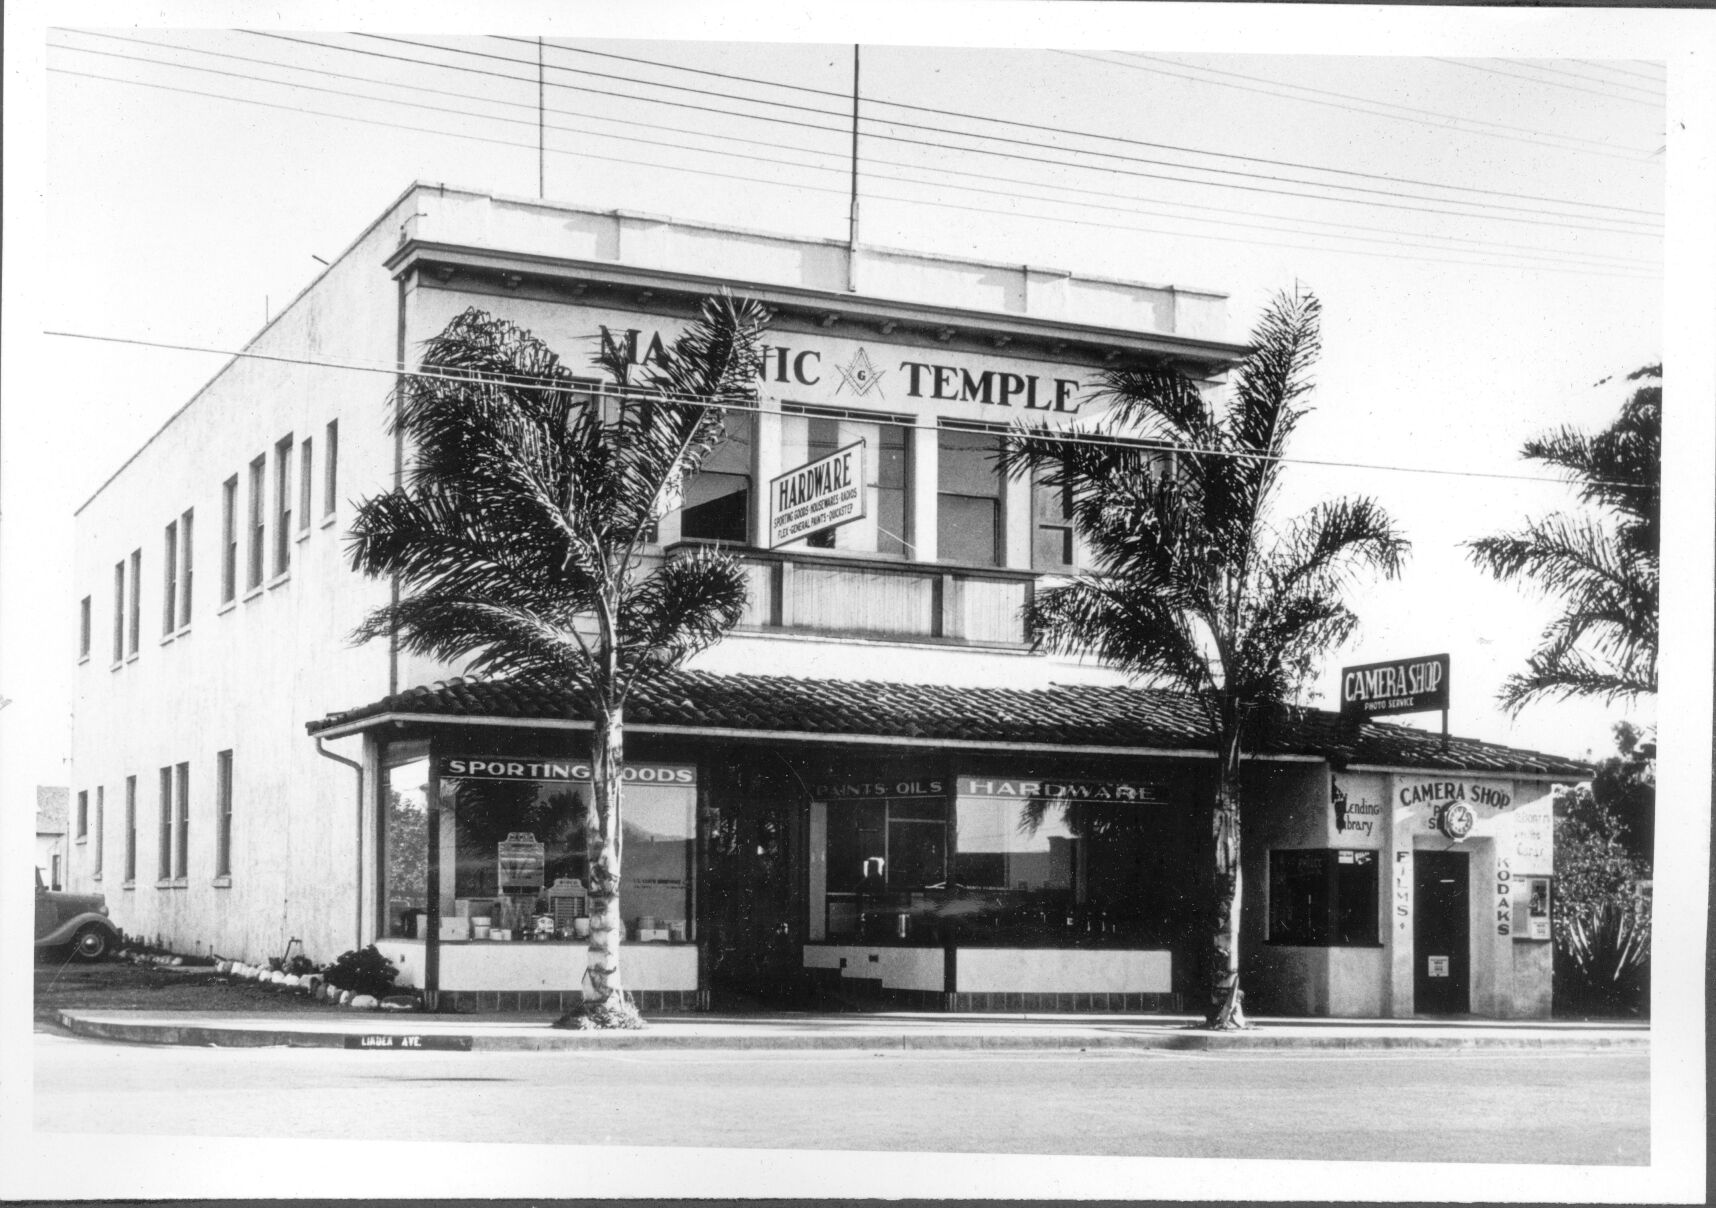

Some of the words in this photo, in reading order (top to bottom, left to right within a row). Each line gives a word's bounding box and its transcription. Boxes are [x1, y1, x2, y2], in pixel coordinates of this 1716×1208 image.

[598, 325, 821, 386] MAIC
[900, 361, 1080, 414] TEMPLE
[857, 370, 866, 381] G
[779, 451, 852, 513] HARDWARE
[774, 511, 794, 529] SPORTING
[794, 505, 809, 520] GOODS
[840, 487, 858, 503] RADIOS
[790, 519, 810, 535] GENERAL
[811, 512, 827, 527] PAINTS
[1345, 665, 1408, 702] CAMERA
[1408, 660, 1442, 695] SHOP
[1364, 700, 1387, 711] PHOTO
[1387, 697, 1414, 709] SERVICE
[449, 760, 591, 779] SPORTING
[619, 766, 693, 783] OODS
[816, 782, 887, 796] PAINTS
[896, 781, 943, 795] OILS
[969, 780, 1157, 801] HARDWARE
[1400, 782, 1466, 807] CAMERA
[1470, 784, 1511, 810] SHOP
[1343, 814, 1373, 837] ibrary
[1396, 851, 1410, 917] FILMS
[1497, 857, 1511, 936] KODAKS
